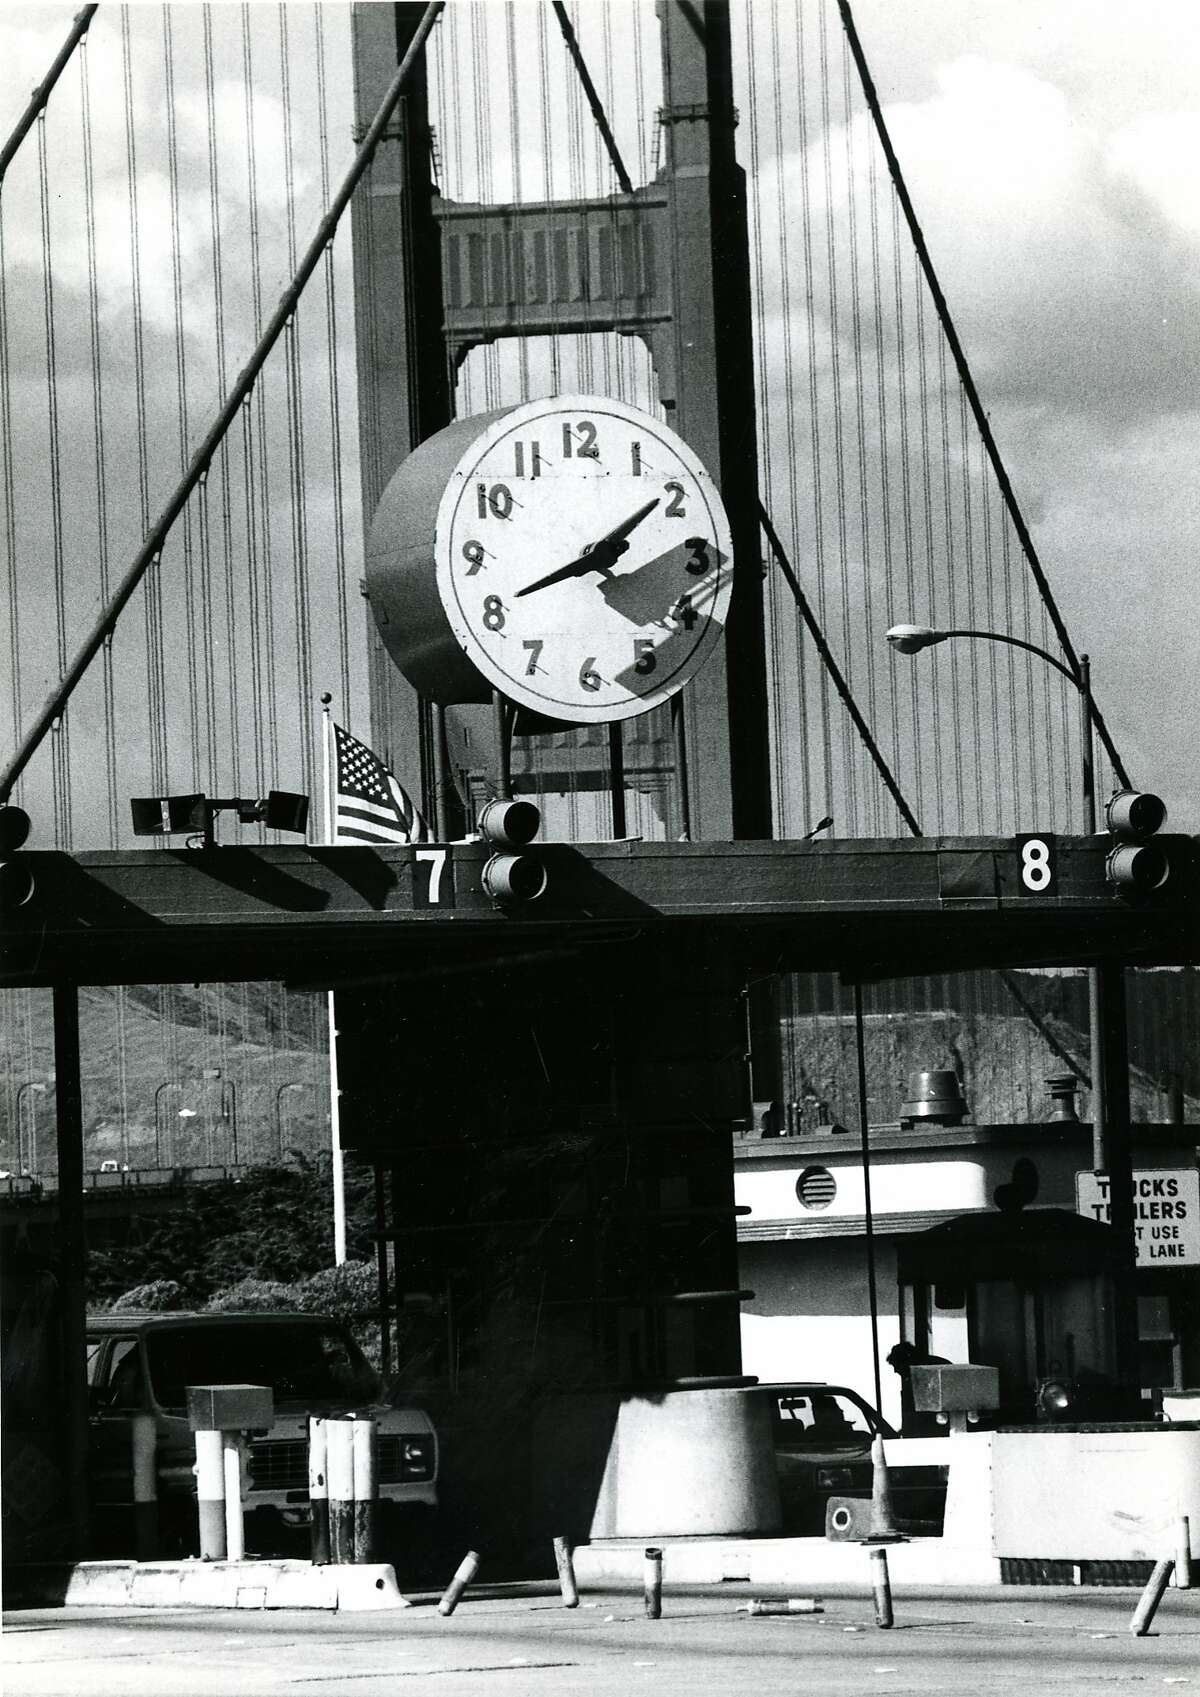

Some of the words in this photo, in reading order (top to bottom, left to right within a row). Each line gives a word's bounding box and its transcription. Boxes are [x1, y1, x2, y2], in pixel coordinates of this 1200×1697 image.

[562, 421, 600, 458] 12
[514, 441, 541, 477] 11
[631, 441, 641, 477] 1
[477, 483, 513, 519] 10
[664, 481, 686, 518] 2
[462, 539, 486, 576] 9
[684, 536, 709, 575] 3
[483, 594, 505, 631] 8
[671, 594, 698, 631] 4
[522, 640, 544, 676] 7
[579, 657, 600, 692] 6
[634, 638, 656, 675] 5
[416, 850, 446, 903] 7
[1022, 839, 1051, 891] 8
[1150, 1244, 1185, 1258] LANE
[1151, 1226, 1179, 1239] USE
